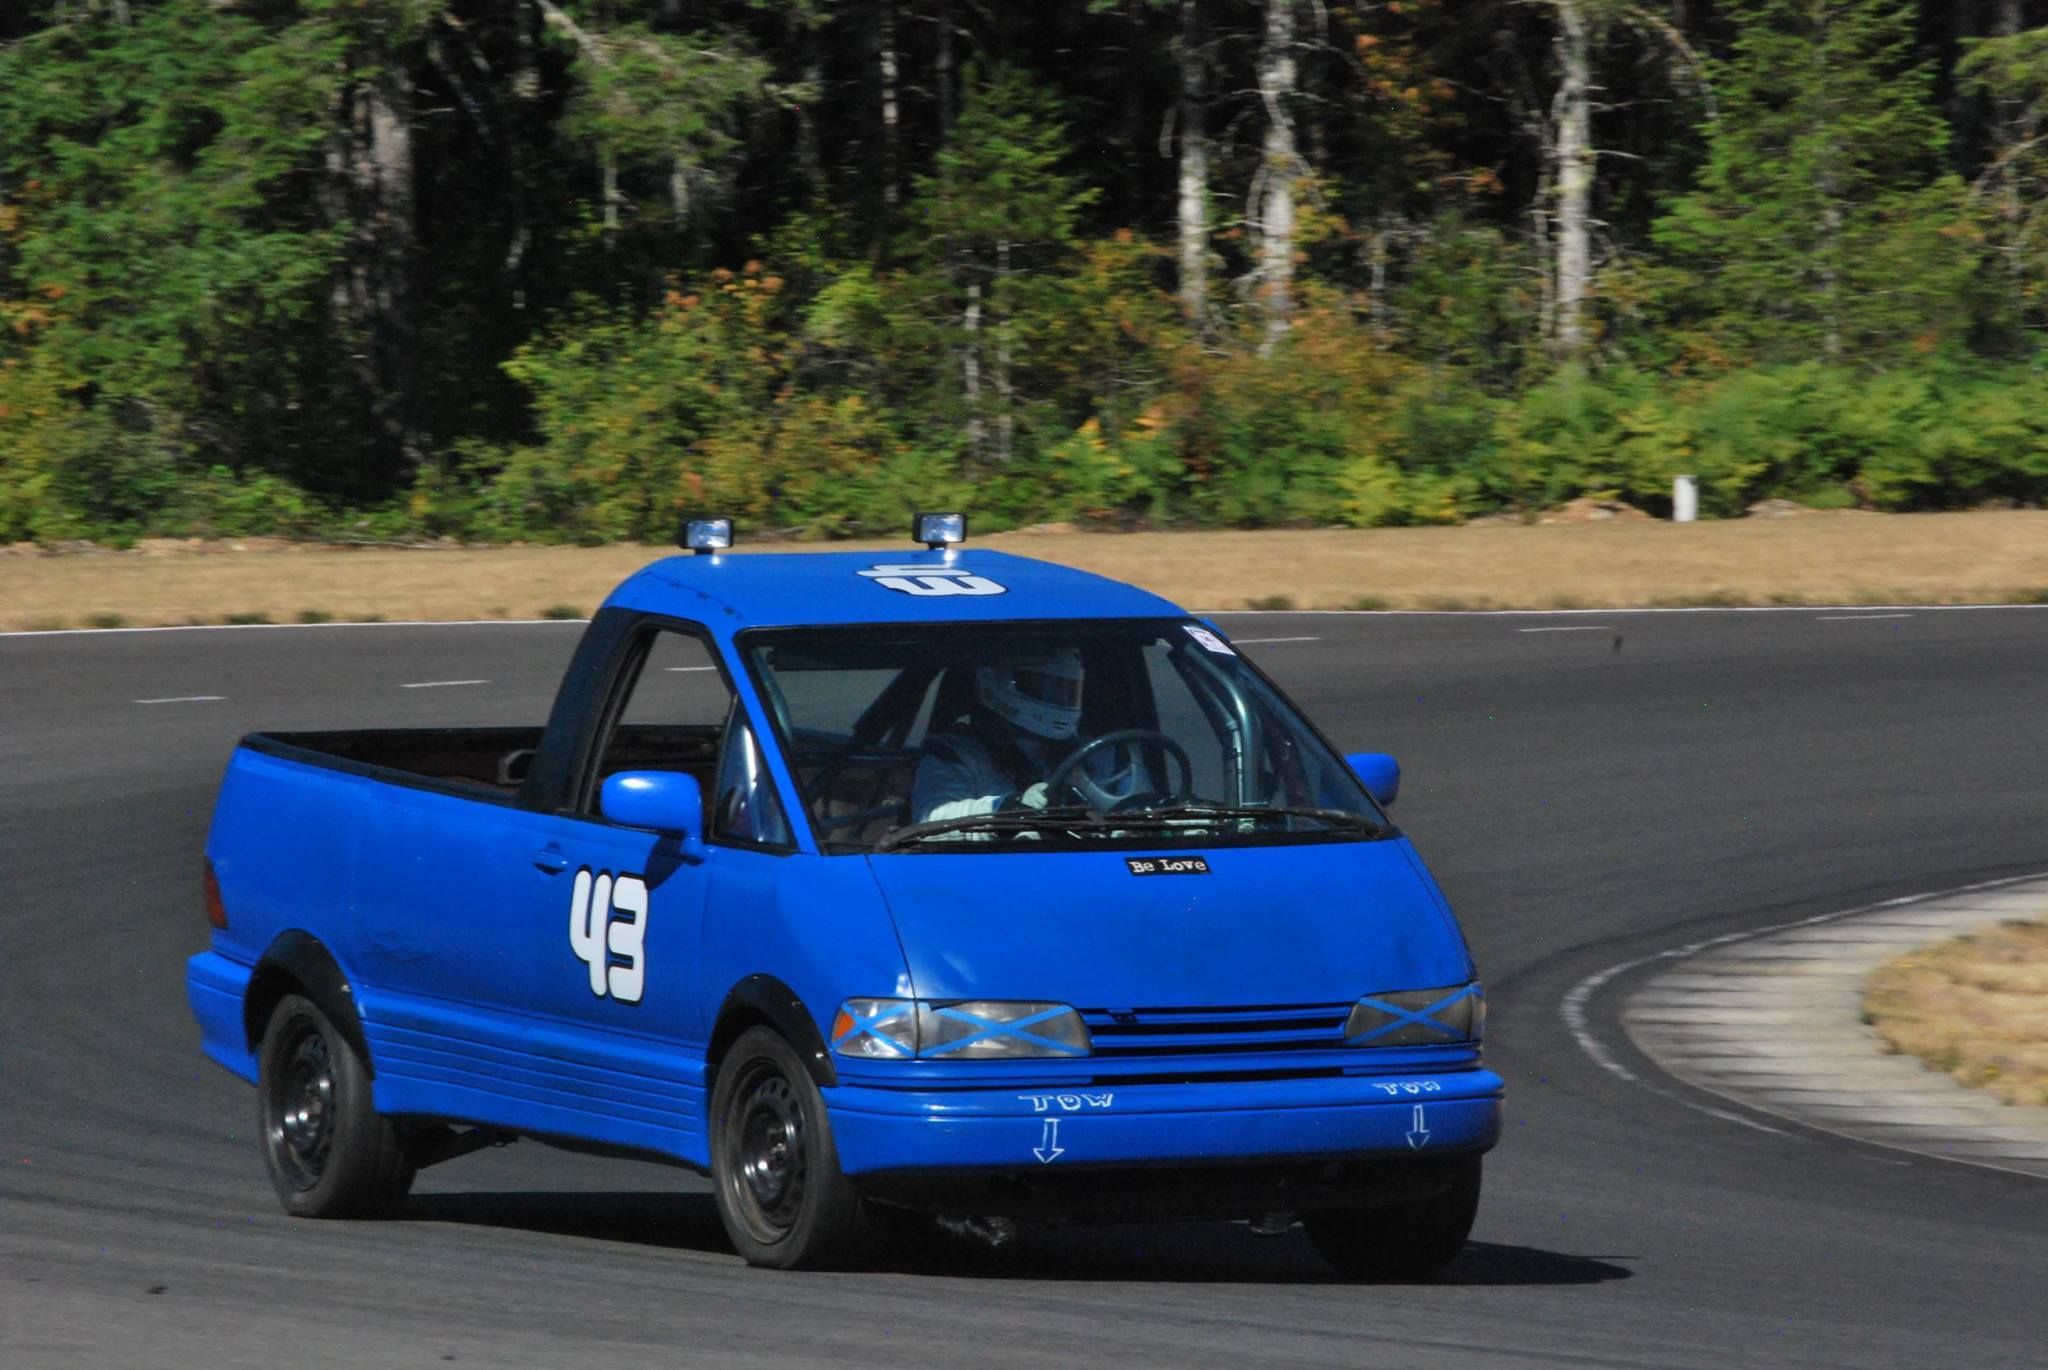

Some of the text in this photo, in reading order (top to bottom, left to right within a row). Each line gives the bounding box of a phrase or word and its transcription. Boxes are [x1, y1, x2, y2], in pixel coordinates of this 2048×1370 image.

[1128, 859, 1207, 873] Be Love
[569, 868, 649, 1003] 43
[1371, 1081, 1441, 1095] TOW
[1017, 1093, 1114, 1112] TOW
